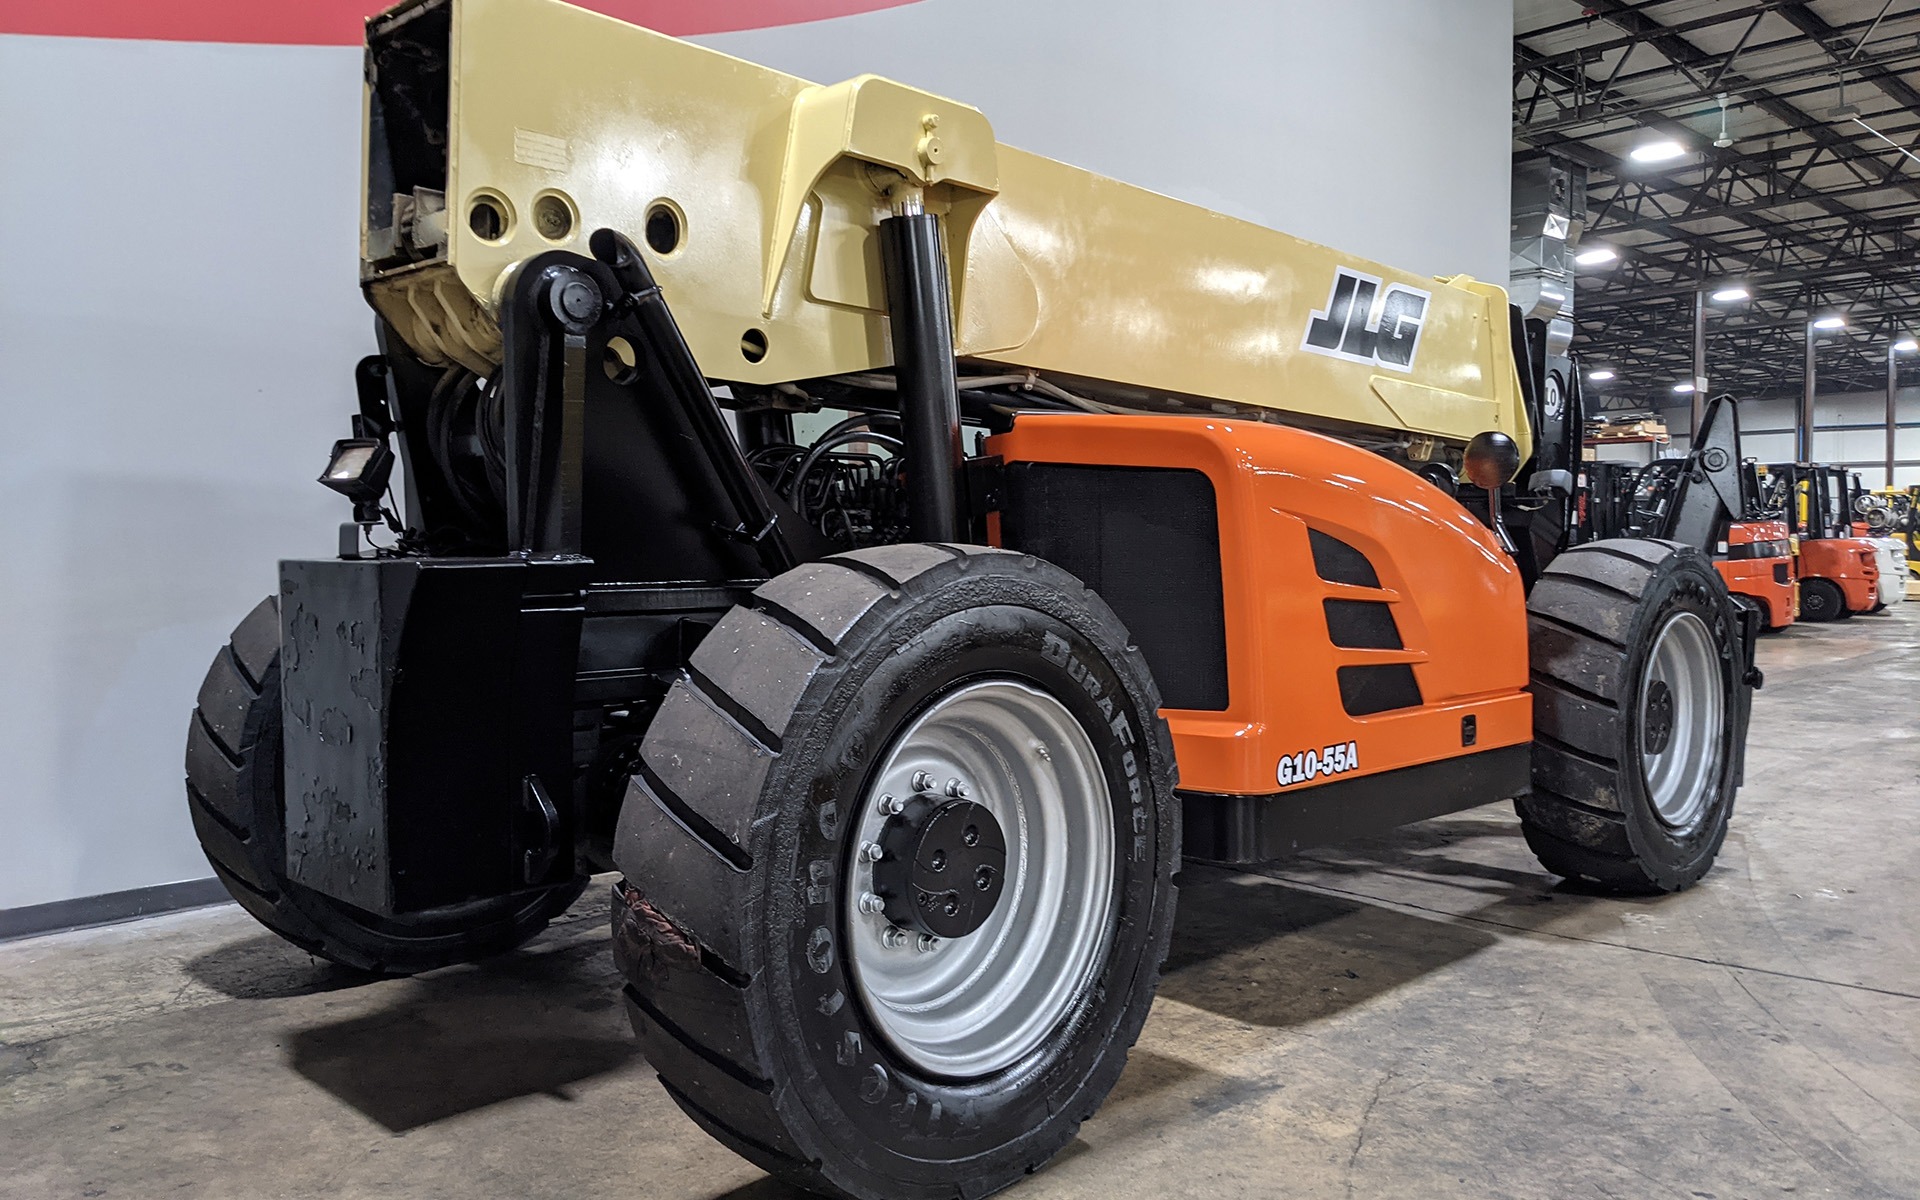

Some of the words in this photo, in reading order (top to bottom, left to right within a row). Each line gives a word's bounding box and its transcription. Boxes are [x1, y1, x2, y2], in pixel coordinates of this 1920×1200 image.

[1304, 271, 1428, 368] JLG
[1041, 630, 1148, 863] DURAFORCE
[1277, 741, 1358, 786] G10-55A
